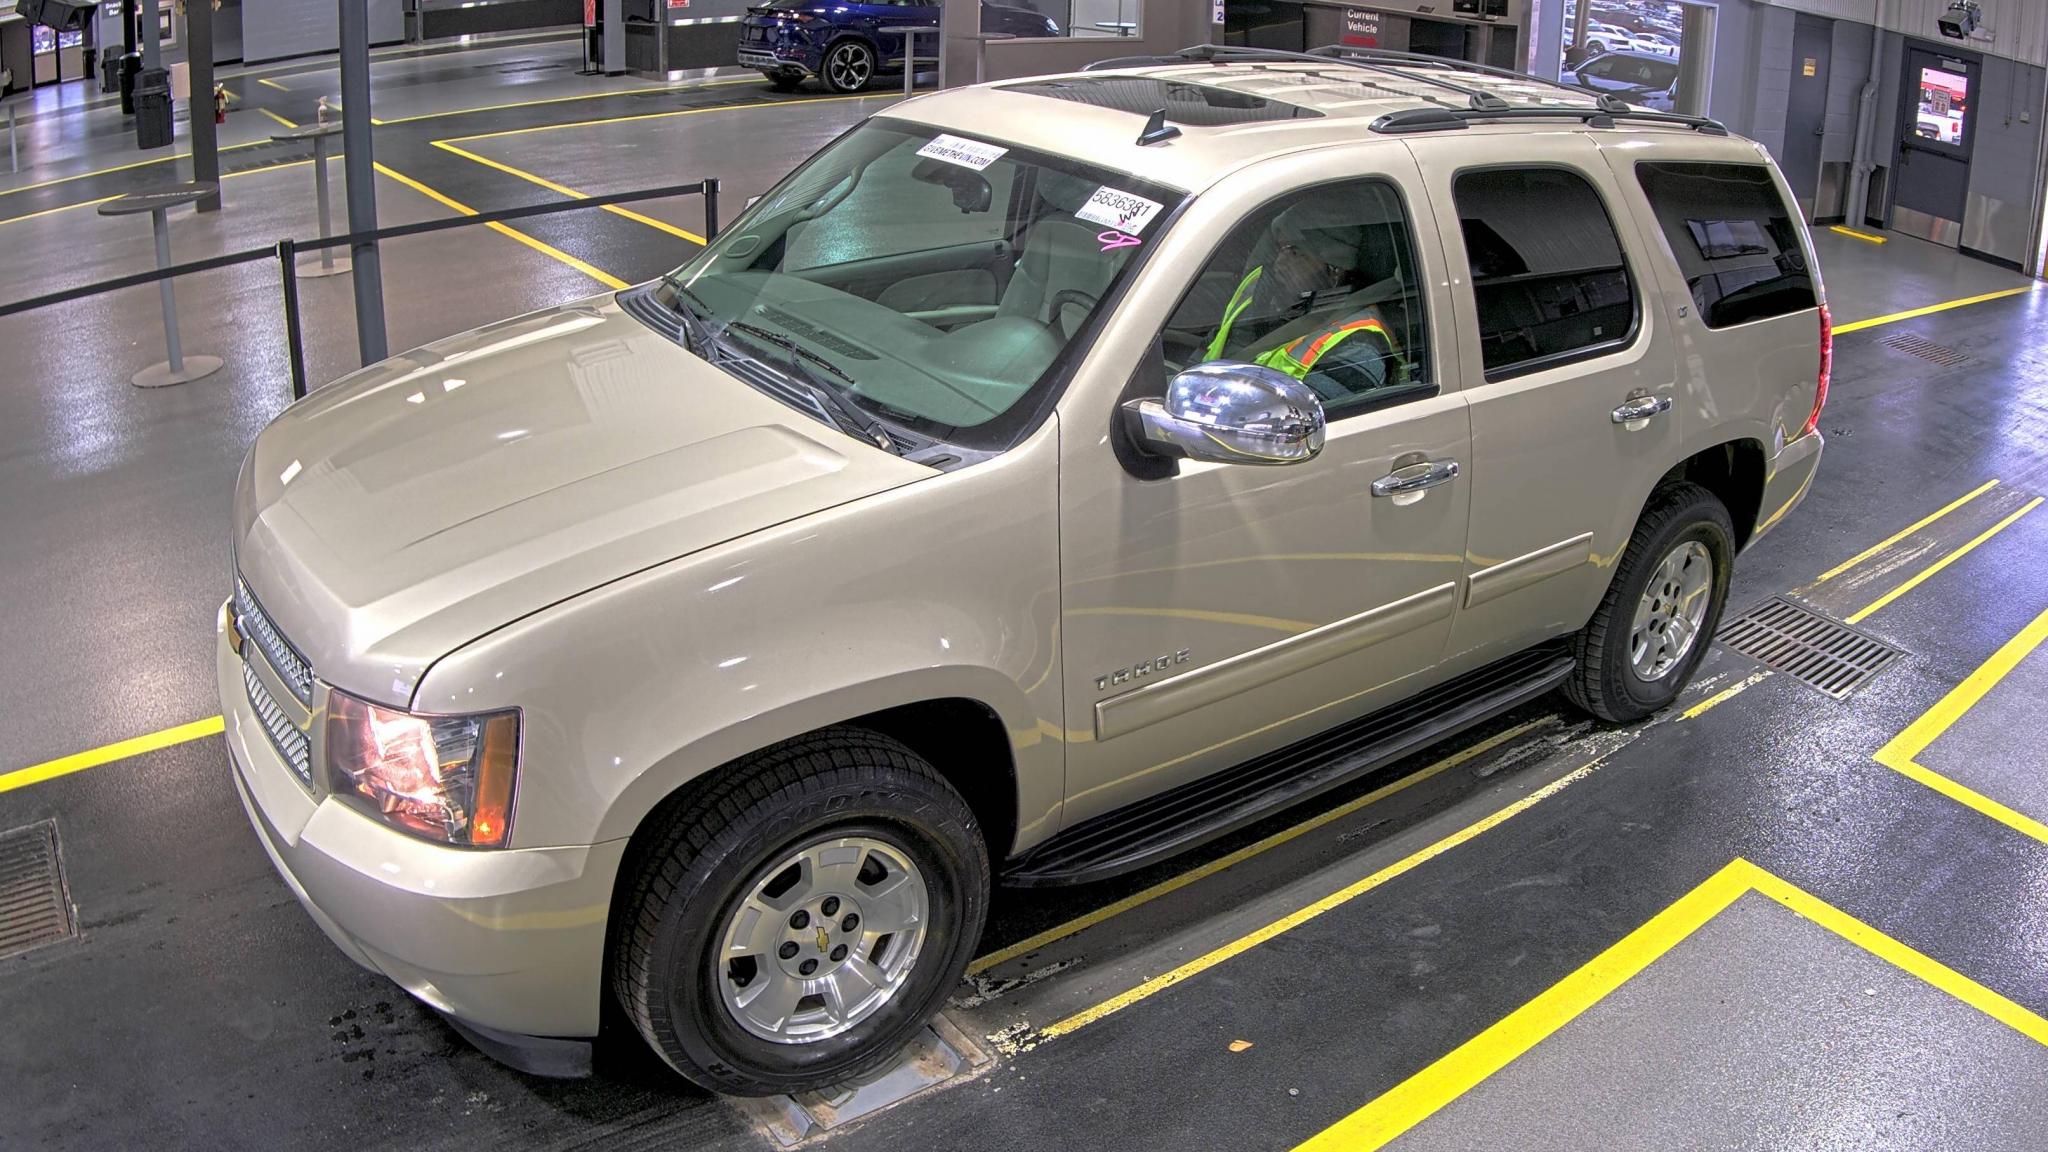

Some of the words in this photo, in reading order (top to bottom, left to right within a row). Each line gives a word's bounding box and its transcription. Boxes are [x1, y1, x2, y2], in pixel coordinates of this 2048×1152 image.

[1217, 11, 1224, 21] 2
[1347, 9, 1379, 21] Current
[1347, 21, 1377, 33] Vehicle
[1092, 190, 1152, 217] 5836381
[1094, 648, 1191, 690] TAHOE
